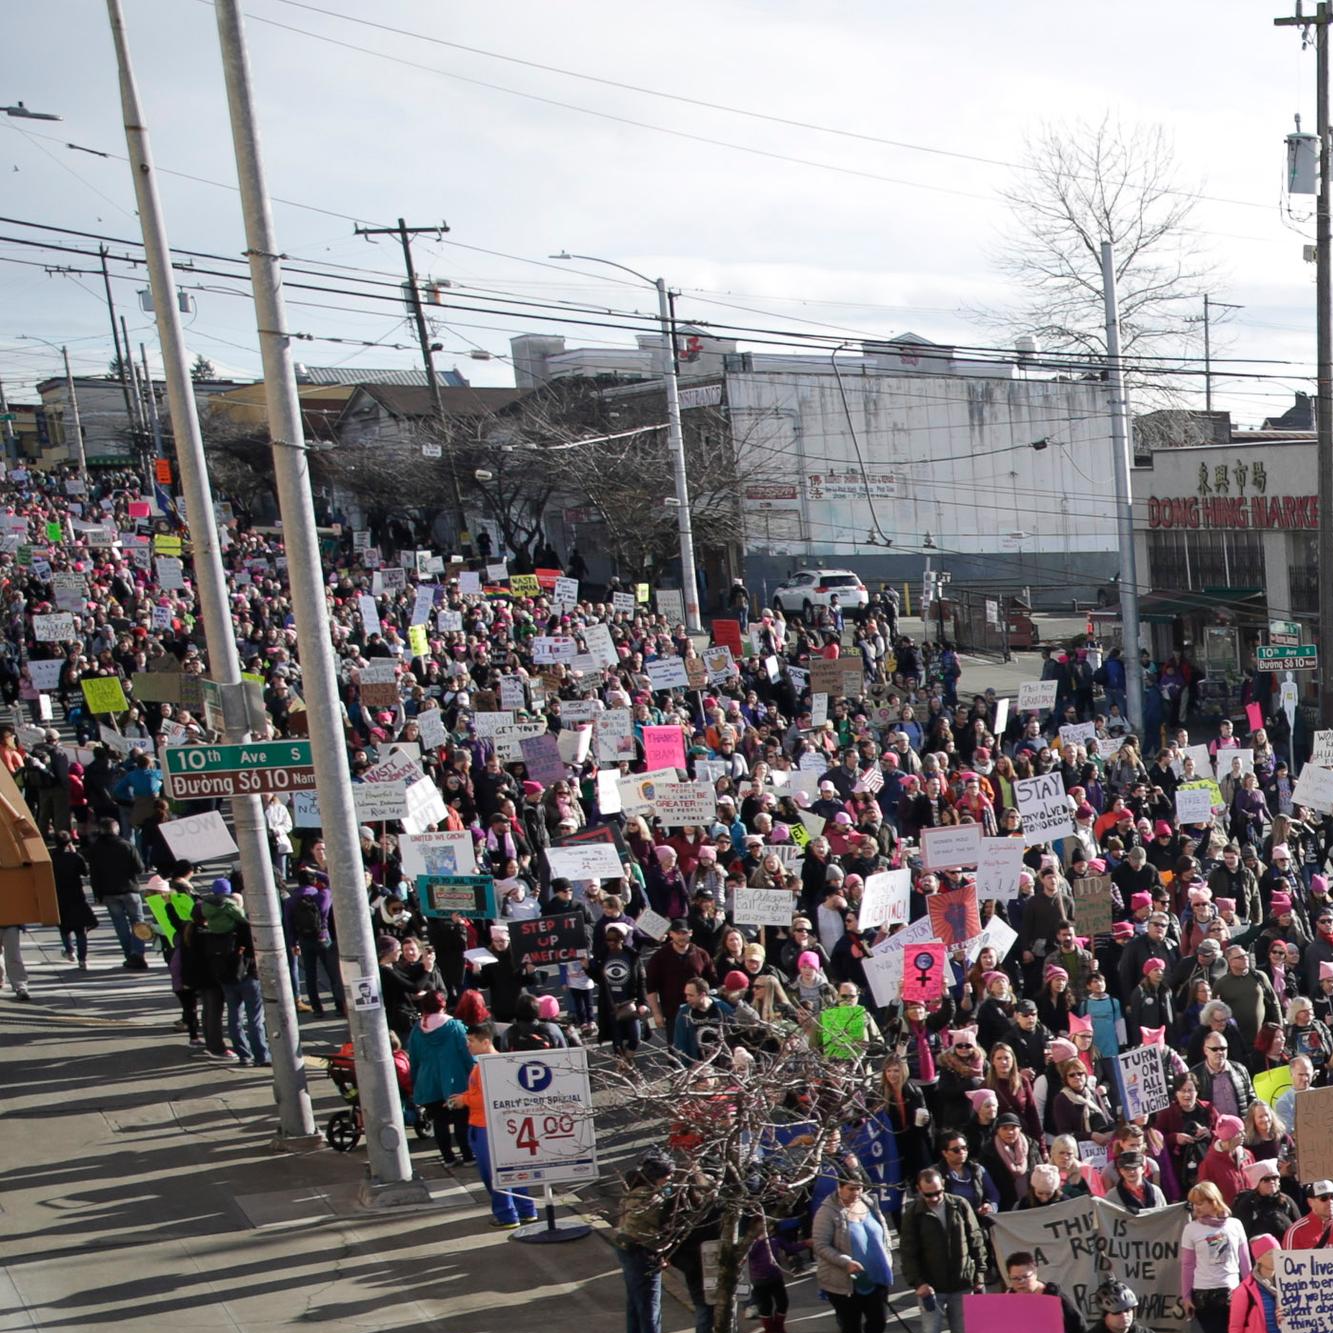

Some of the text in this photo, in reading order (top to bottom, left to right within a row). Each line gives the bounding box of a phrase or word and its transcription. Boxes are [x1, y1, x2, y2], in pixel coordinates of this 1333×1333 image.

[1150, 496, 1249, 528] DONG HING
[1262, 648, 1280, 658] 10th
[1296, 658, 1305, 667] 10
[496, 724, 540, 735] GET YOUR
[177, 748, 300, 770] 10th Ave S
[174, 775, 234, 795] Đường
[239, 769, 261, 790] Số
[265, 769, 289, 788] 10
[1017, 774, 1060, 803] STAY
[696, 791, 708, 799] BE
[656, 800, 696, 808] GREATER
[1022, 802, 1068, 823] INVOLVED
[521, 917, 576, 935] STEP IT
[538, 935, 558, 948] UP
[521, 948, 578, 964] AMERICA
[1121, 1050, 1157, 1069] TURN
[1142, 1062, 1160, 1076] ON
[1143, 1075, 1162, 1091] ALL
[1146, 1088, 1165, 1098] THE
[493, 1098, 521, 1109] EARLY
[1141, 1096, 1169, 1113] LIGHTS
[1113, 1219, 1127, 1237] IS
[1125, 1262, 1155, 1280] WE
[1279, 1278, 1308, 1297] begin
[1309, 1277, 1320, 1288] to
[1281, 1293, 1301, 1307] day
[1305, 1293, 1319, 1302] we
[1283, 1301, 1312, 1317] silent
[1288, 1314, 1325, 1330] things
